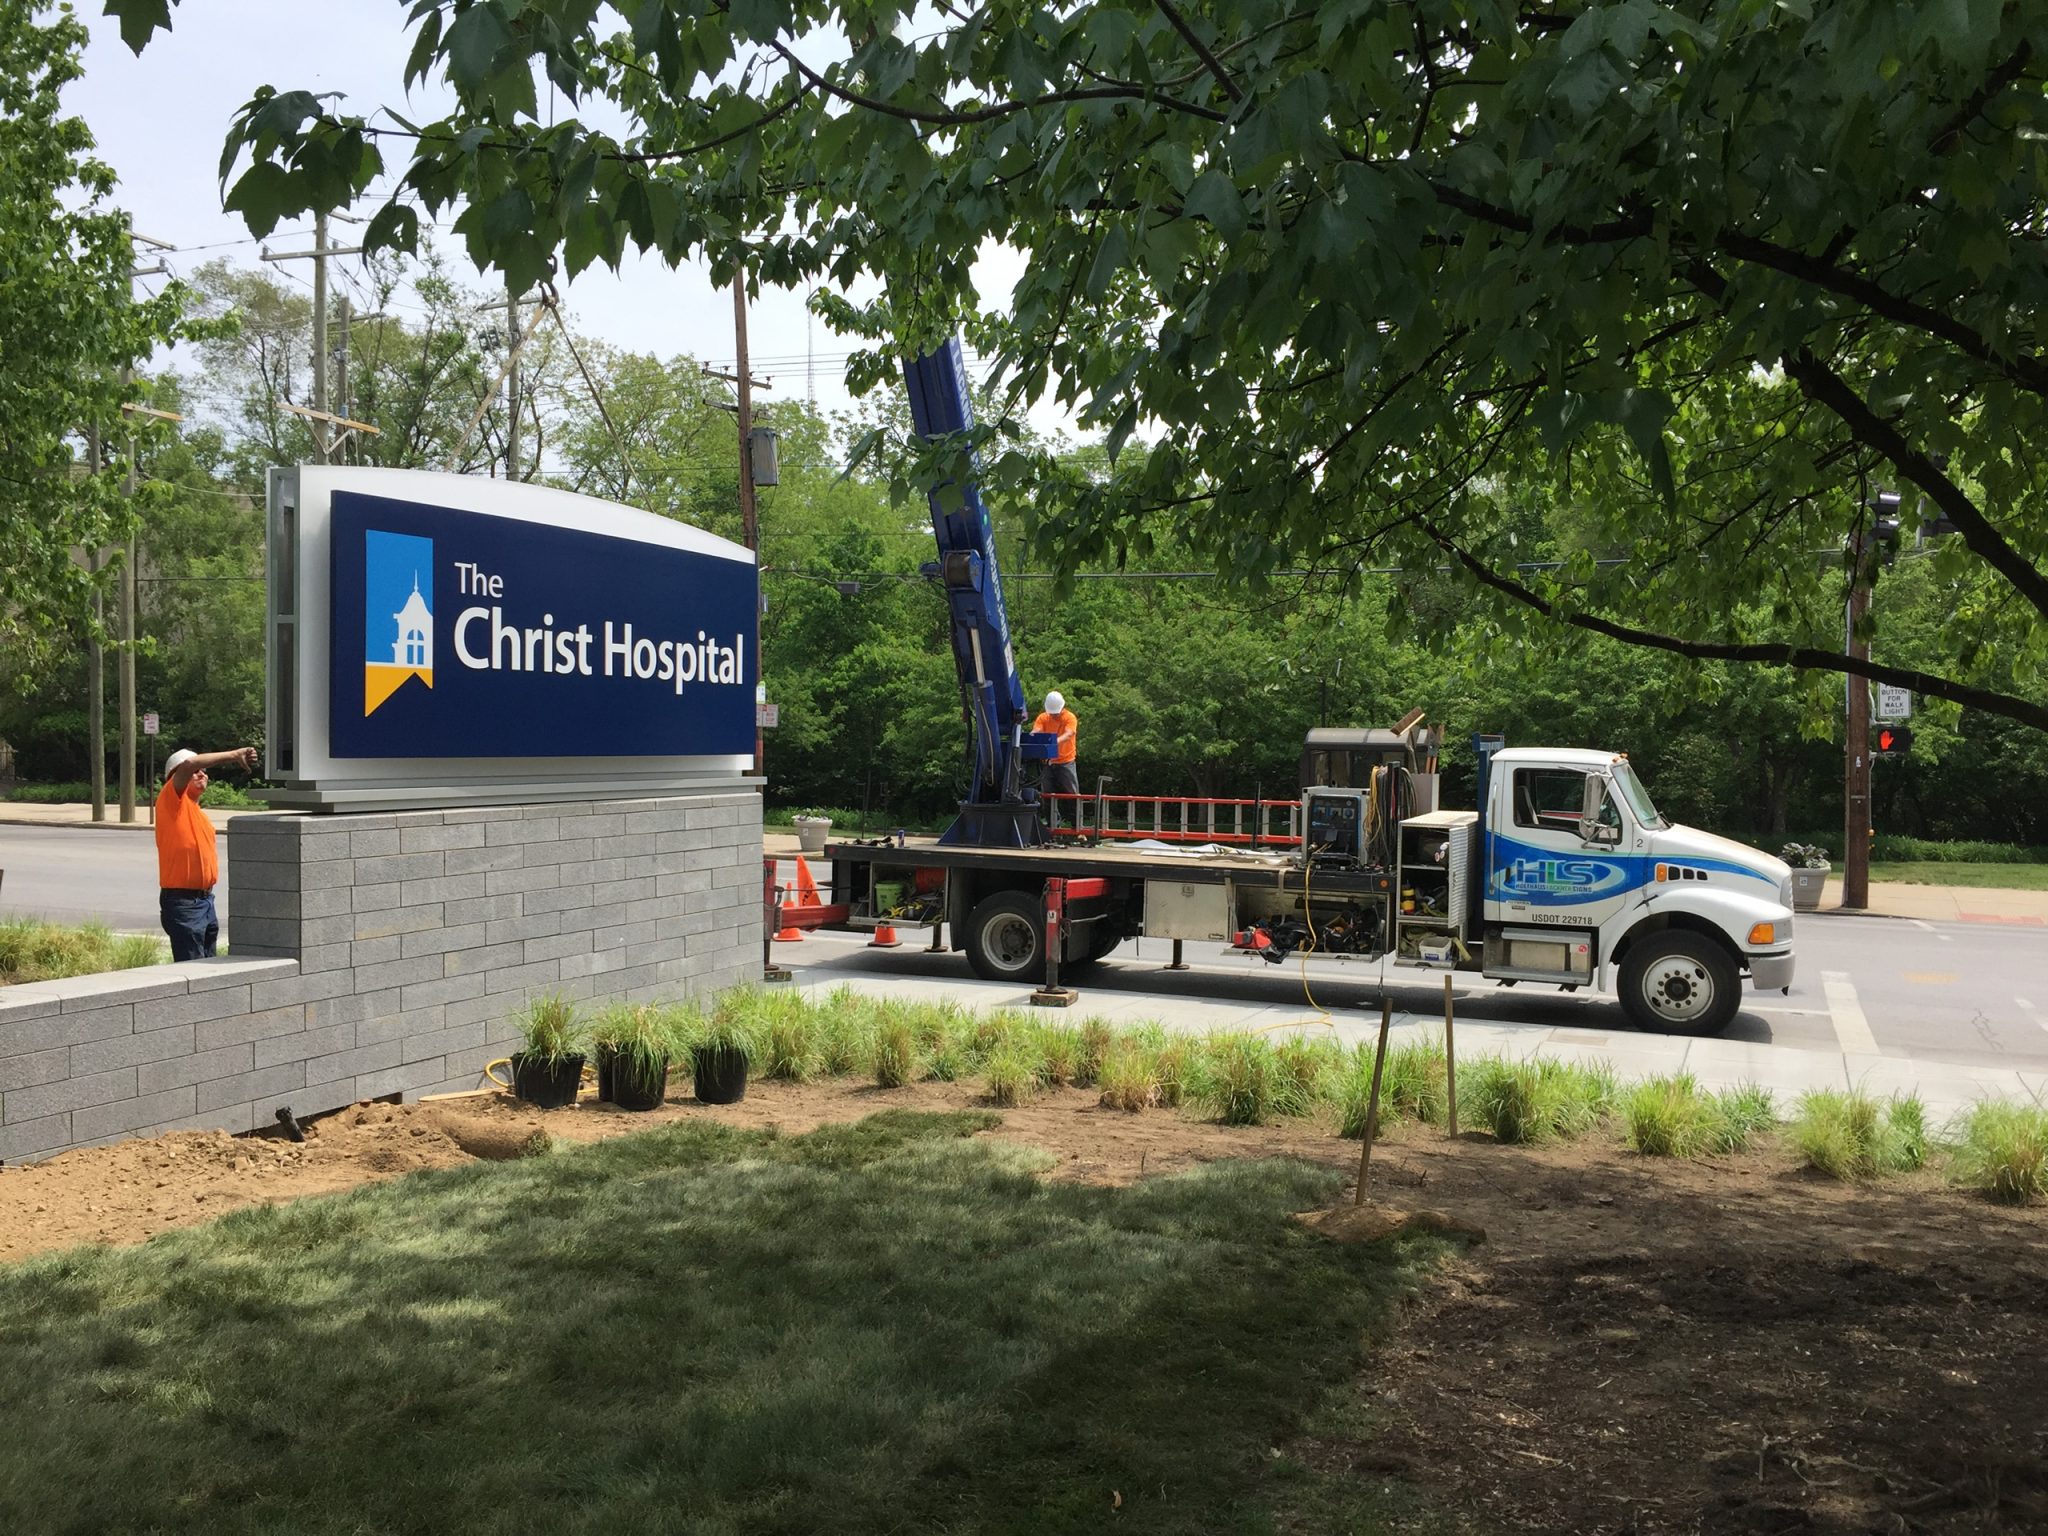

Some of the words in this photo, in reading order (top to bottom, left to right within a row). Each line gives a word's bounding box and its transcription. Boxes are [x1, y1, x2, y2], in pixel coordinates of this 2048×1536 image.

[454, 562, 504, 598] The
[454, 606, 593, 676] Christ
[604, 620, 744, 695] Hospital
[1636, 838, 1644, 848] 2
[1515, 858, 1595, 885] HLS
[1573, 885, 1592, 893] SIGNS
[1531, 913, 1560, 924] USDOT
[1562, 915, 1593, 925] 229718
